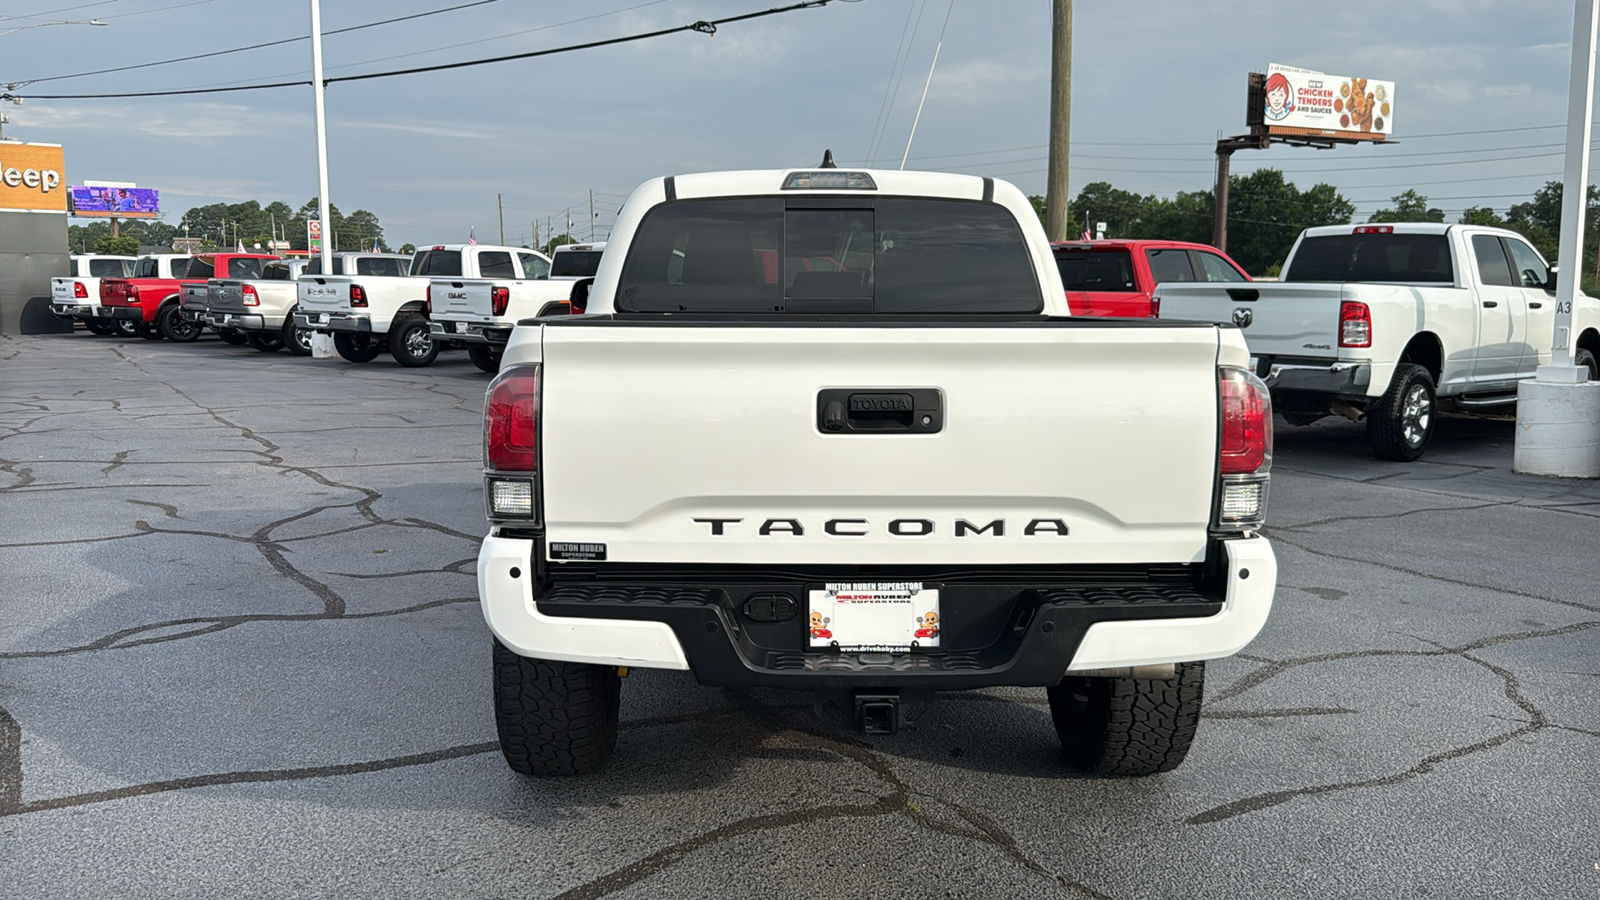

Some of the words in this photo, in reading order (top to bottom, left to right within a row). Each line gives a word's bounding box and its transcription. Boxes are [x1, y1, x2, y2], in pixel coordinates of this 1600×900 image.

[1297, 87, 1333, 98] CHICKEN
[1297, 96, 1333, 107] TENDERS
[448, 292, 467, 300] GMC
[1556, 301, 1571, 314] A3
[853, 397, 909, 410] TOYOTA
[692, 517, 1070, 536] TACOMA
[552, 543, 579, 552] MILTON
[580, 544, 604, 552] RUBEN
[825, 582, 852, 591] MILTON
[852, 582, 877, 591] RUBEN
[877, 582, 923, 590] SUPERSTORE
[839, 644, 911, 653] www.drivebaby.com
